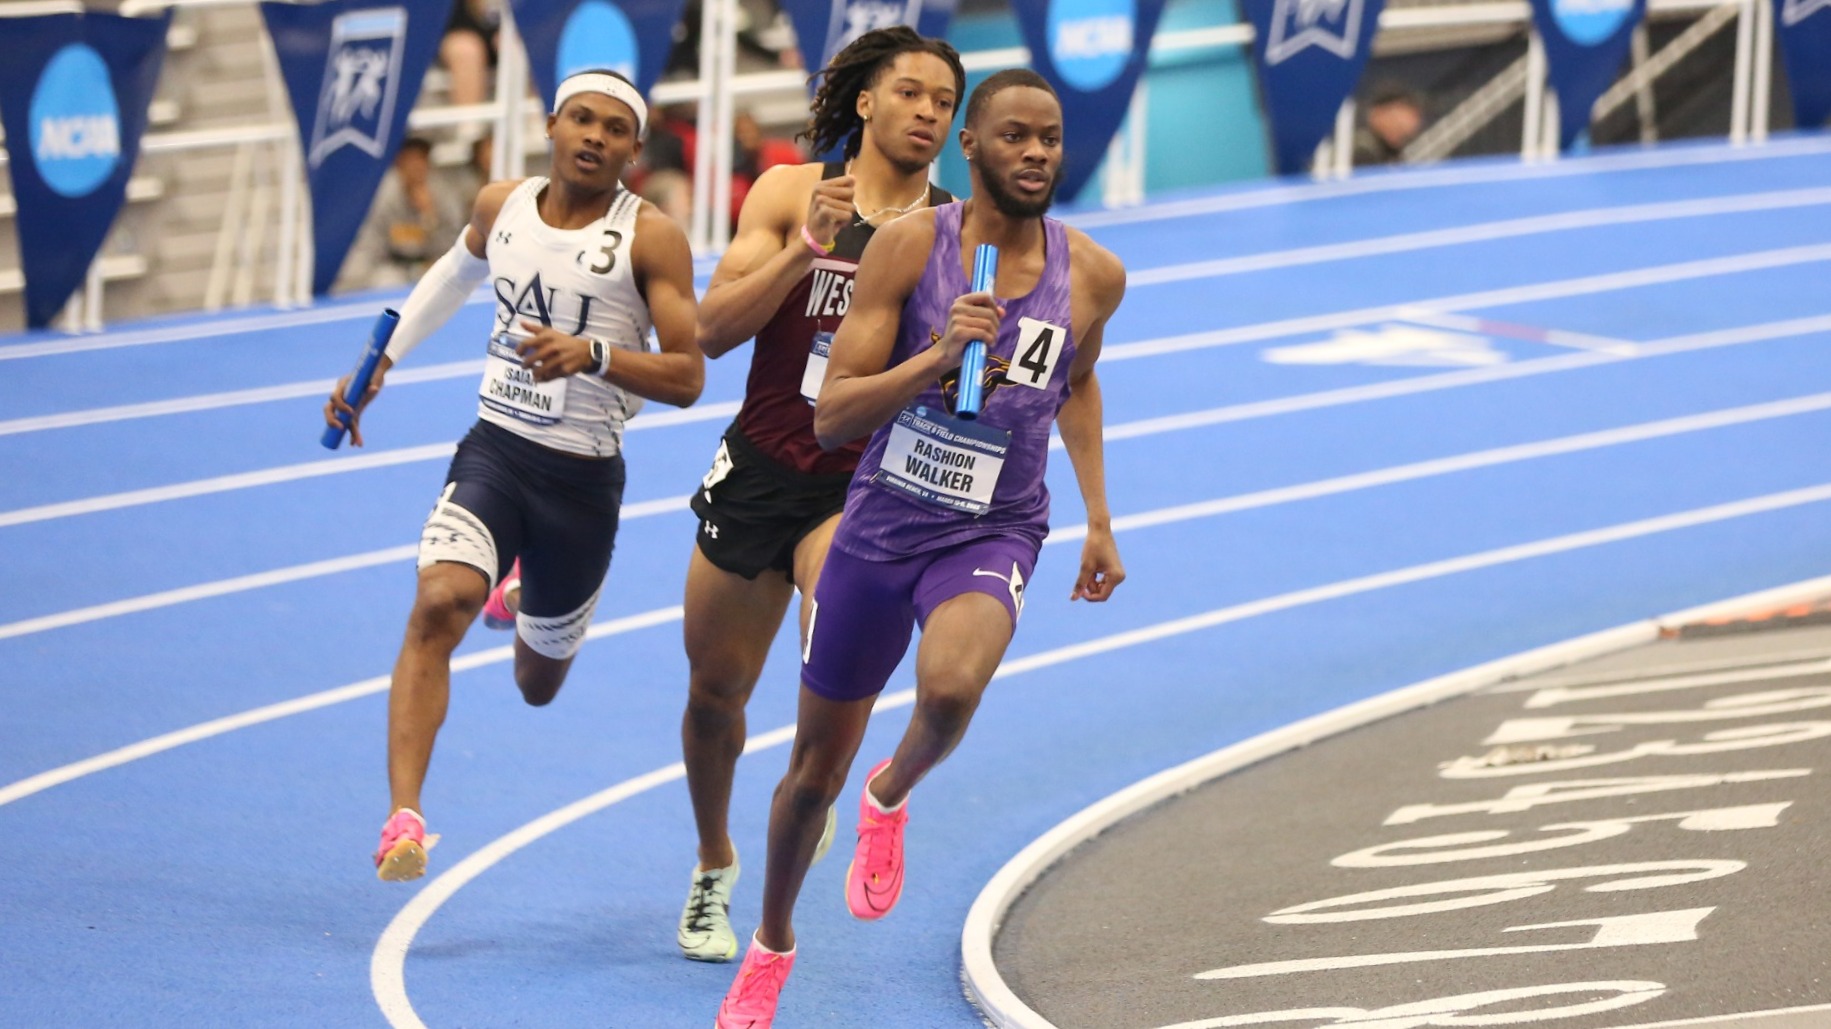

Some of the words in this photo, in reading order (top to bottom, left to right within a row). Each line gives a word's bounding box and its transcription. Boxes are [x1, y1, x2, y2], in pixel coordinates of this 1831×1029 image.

[1053, 14, 1133, 60] NCAA
[37, 114, 119, 161] NCAA
[590, 230, 622, 275] 3
[493, 270, 599, 336] SAU
[504, 365, 538, 388] ISAIA
[1018, 327, 1054, 384] 4
[489, 378, 552, 412] CHAPMAN
[913, 438, 976, 470] RASHION
[935, 428, 954, 441] FIELD
[905, 455, 974, 493] WALKER
[1382, 768, 1814, 826] 4
[1329, 801, 1794, 868] 5
[1261, 859, 1748, 925] 6
[1193, 905, 1717, 980] 7
